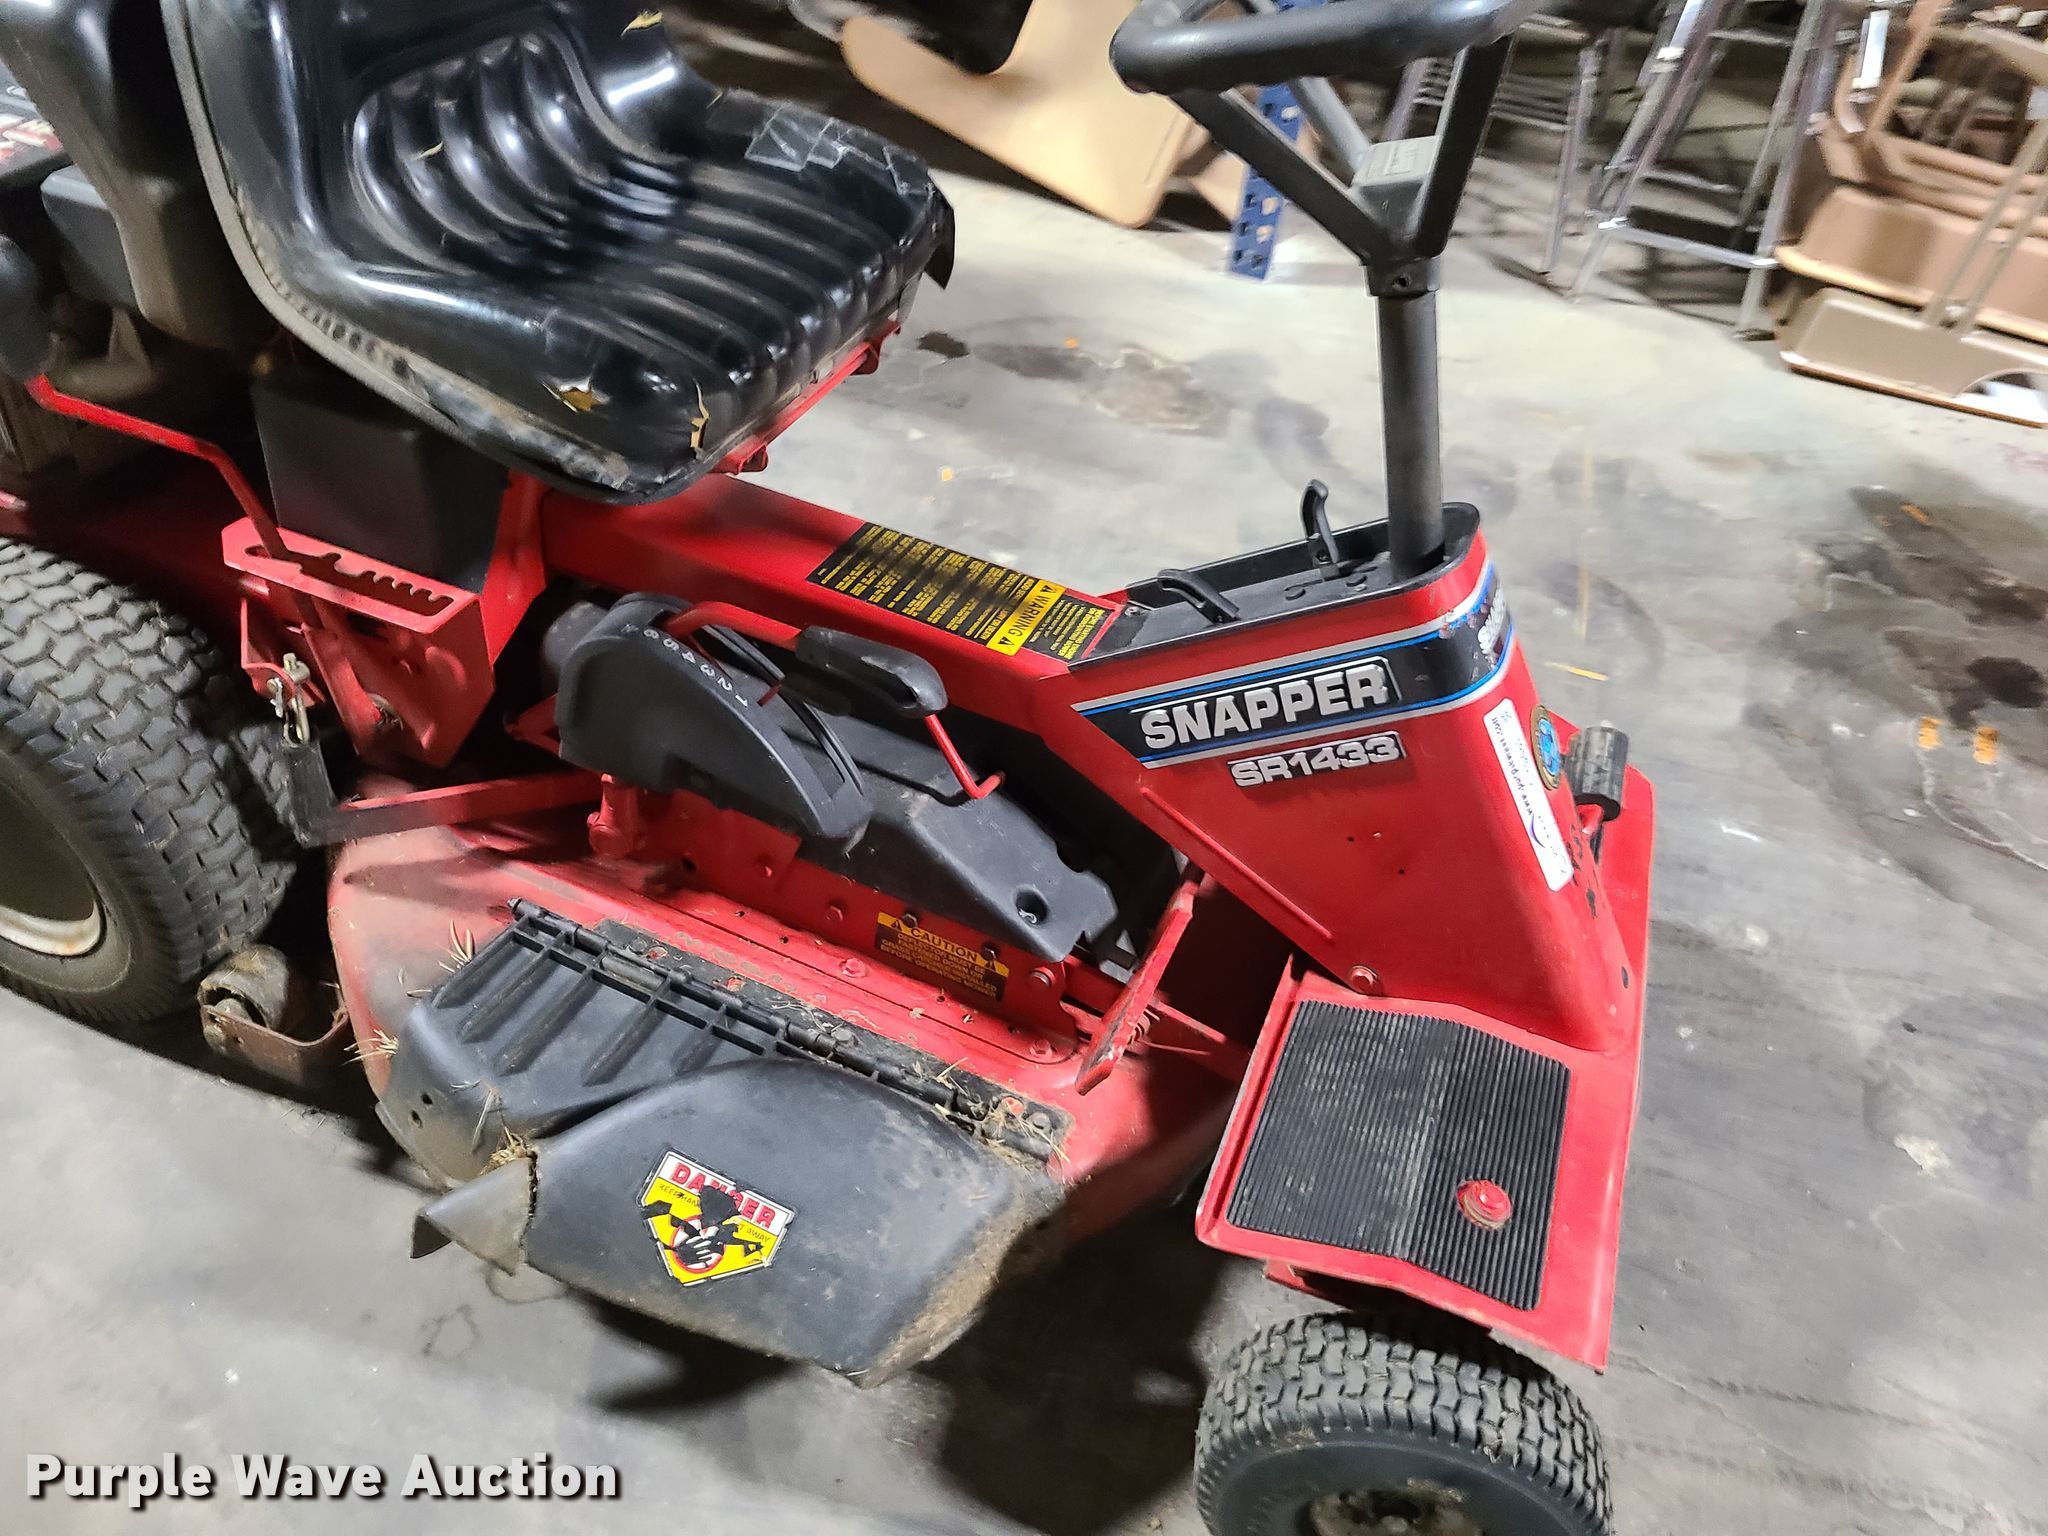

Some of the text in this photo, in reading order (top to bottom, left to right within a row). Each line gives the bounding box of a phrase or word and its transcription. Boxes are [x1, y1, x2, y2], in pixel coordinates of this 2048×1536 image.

[1006, 593, 1051, 637] WARNING
[663, 638, 679, 651] 5
[682, 651, 696, 663] 4
[700, 664, 715, 677] 3
[717, 677, 732, 691] 2
[735, 694, 748, 707] 1
[1140, 663, 1388, 749] SNAPPER
[1231, 737, 1401, 788] SR1433
[910, 926, 977, 962] CAUTION
